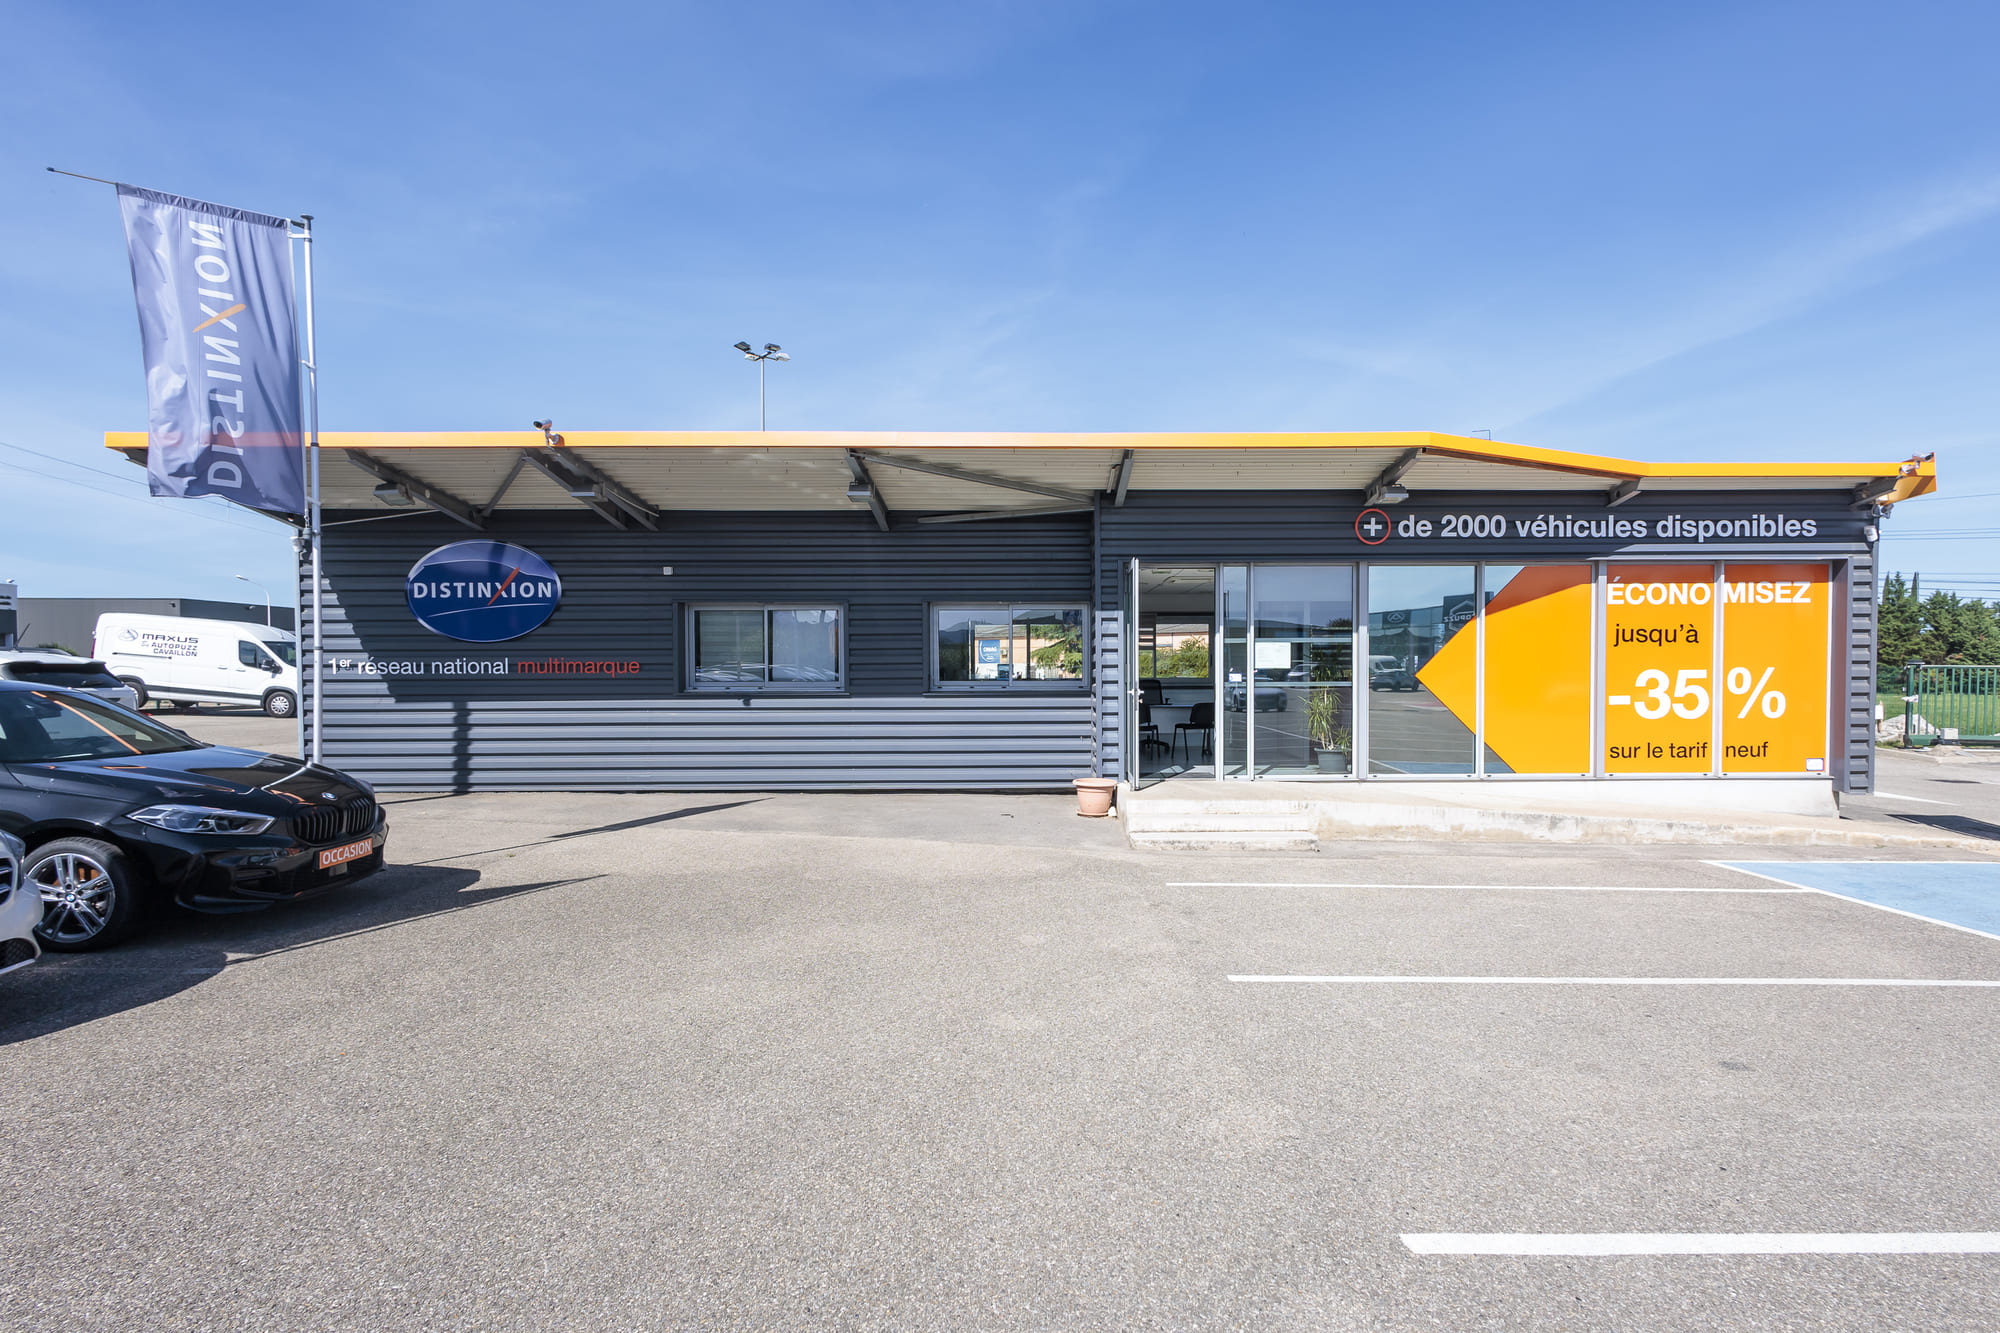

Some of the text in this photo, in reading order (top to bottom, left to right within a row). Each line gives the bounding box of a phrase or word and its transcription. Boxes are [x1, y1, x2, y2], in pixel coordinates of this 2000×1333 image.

[1397, 514, 1433, 538] de
[1440, 514, 1507, 538] 2000
[1515, 514, 1648, 538] véhicules
[1656, 514, 1818, 543] disponibles
[413, 575, 553, 603] DISTINXION
[142, 633, 199, 643] MAXUS
[151, 642, 198, 650] AUTOPUZZ
[1613, 623, 1699, 647] jusqu'à
[153, 648, 198, 656] CAVAILLON
[327, 656, 641, 678] 1er réseau national multimarque
[1726, 666, 1787, 719] %
[1609, 741, 1769, 759] sur le tarif neuf
[322, 840, 372, 865] OCCASION
